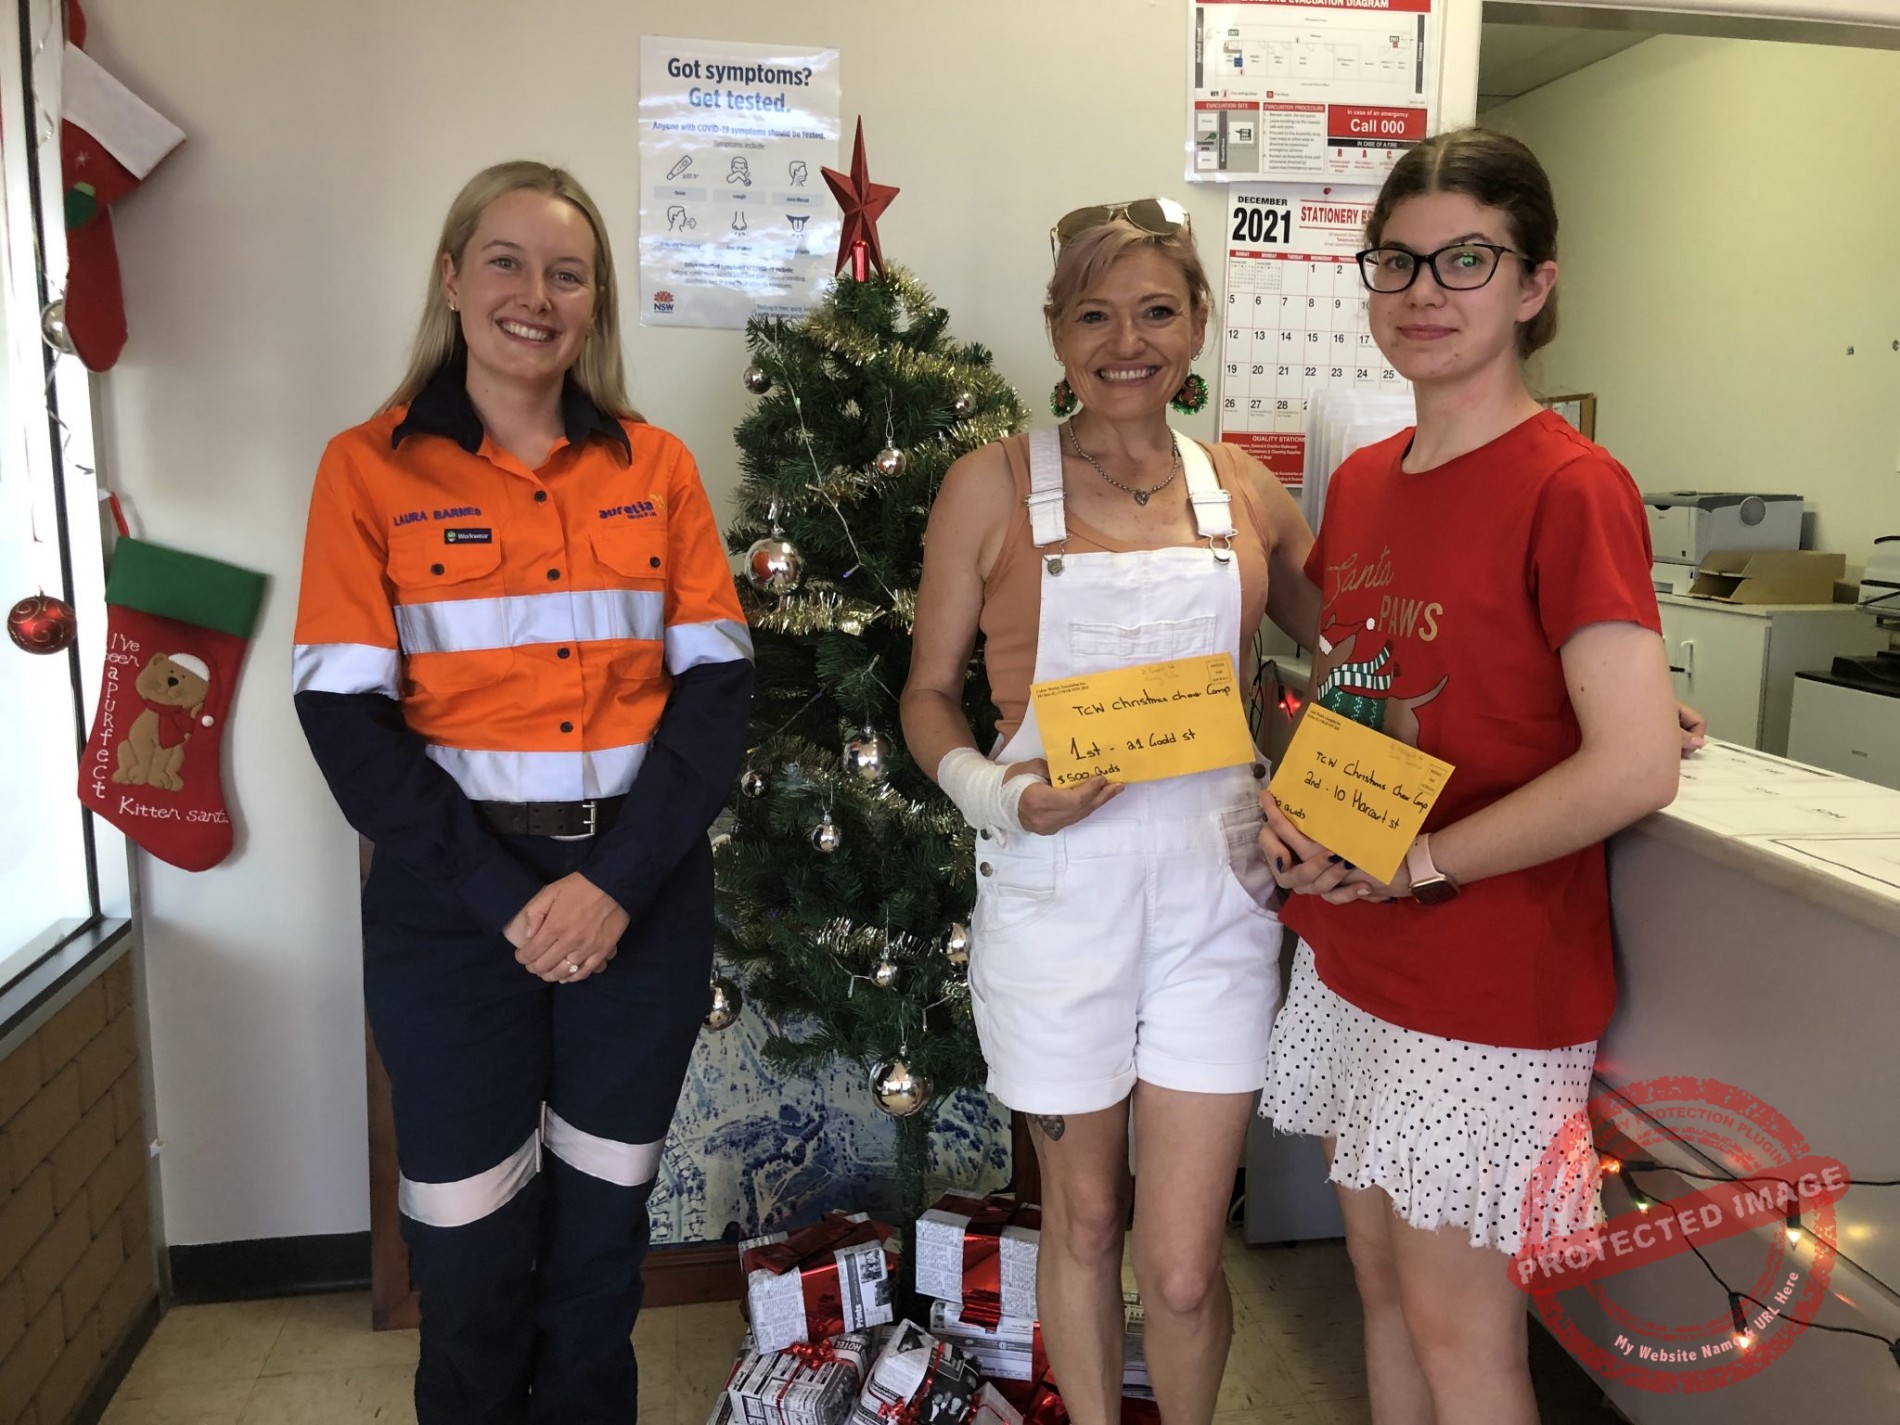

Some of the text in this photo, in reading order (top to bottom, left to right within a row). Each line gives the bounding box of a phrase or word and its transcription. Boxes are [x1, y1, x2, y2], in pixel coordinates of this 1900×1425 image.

[1346, 0, 1389, 8] DIAGRAM
[667, 58, 813, 87] Got symptoms?
[688, 87, 792, 113] Get tested.
[652, 121, 826, 140] Anyone with COVID-19 symptoms should be tested.
[1350, 119, 1405, 134] Call 000
[714, 140, 743, 150] Symptoms
[1362, 150, 1367, 158] A
[1238, 196, 1288, 206] DECEMBER
[1301, 206, 1360, 225] STATIONERY
[1232, 207, 1291, 244] 2021
[1311, 264, 1343, 274] 1 2
[1229, 294, 1235, 304] 5
[1255, 296, 1262, 305] 6
[1282, 298, 1288, 307] 7
[1308, 298, 1314, 308] 8
[1335, 299, 1341, 309] 9
[1228, 330, 1370, 344] 12 13 14 15 16 17
[1227, 365, 1394, 379] 19 20 21 22 23 24 25
[1224, 399, 1235, 408] 26
[1250, 400, 1262, 409] 27
[1277, 401, 1288, 410] 28
[393, 507, 482, 527] LAURA BARNES
[1378, 595, 1444, 642] PAWS
[111, 633, 140, 652] I've
[1072, 704, 1105, 717] TCW
[1070, 737, 1101, 760] 1st
[1316, 752, 1338, 768] TCW
[1304, 771, 1322, 790] 2nd
[1334, 785, 1346, 802] 10
[119, 796, 181, 821] Kitten
[856, 1303, 865, 1328] Prints
[836, 1340, 862, 1352] HOTEL
